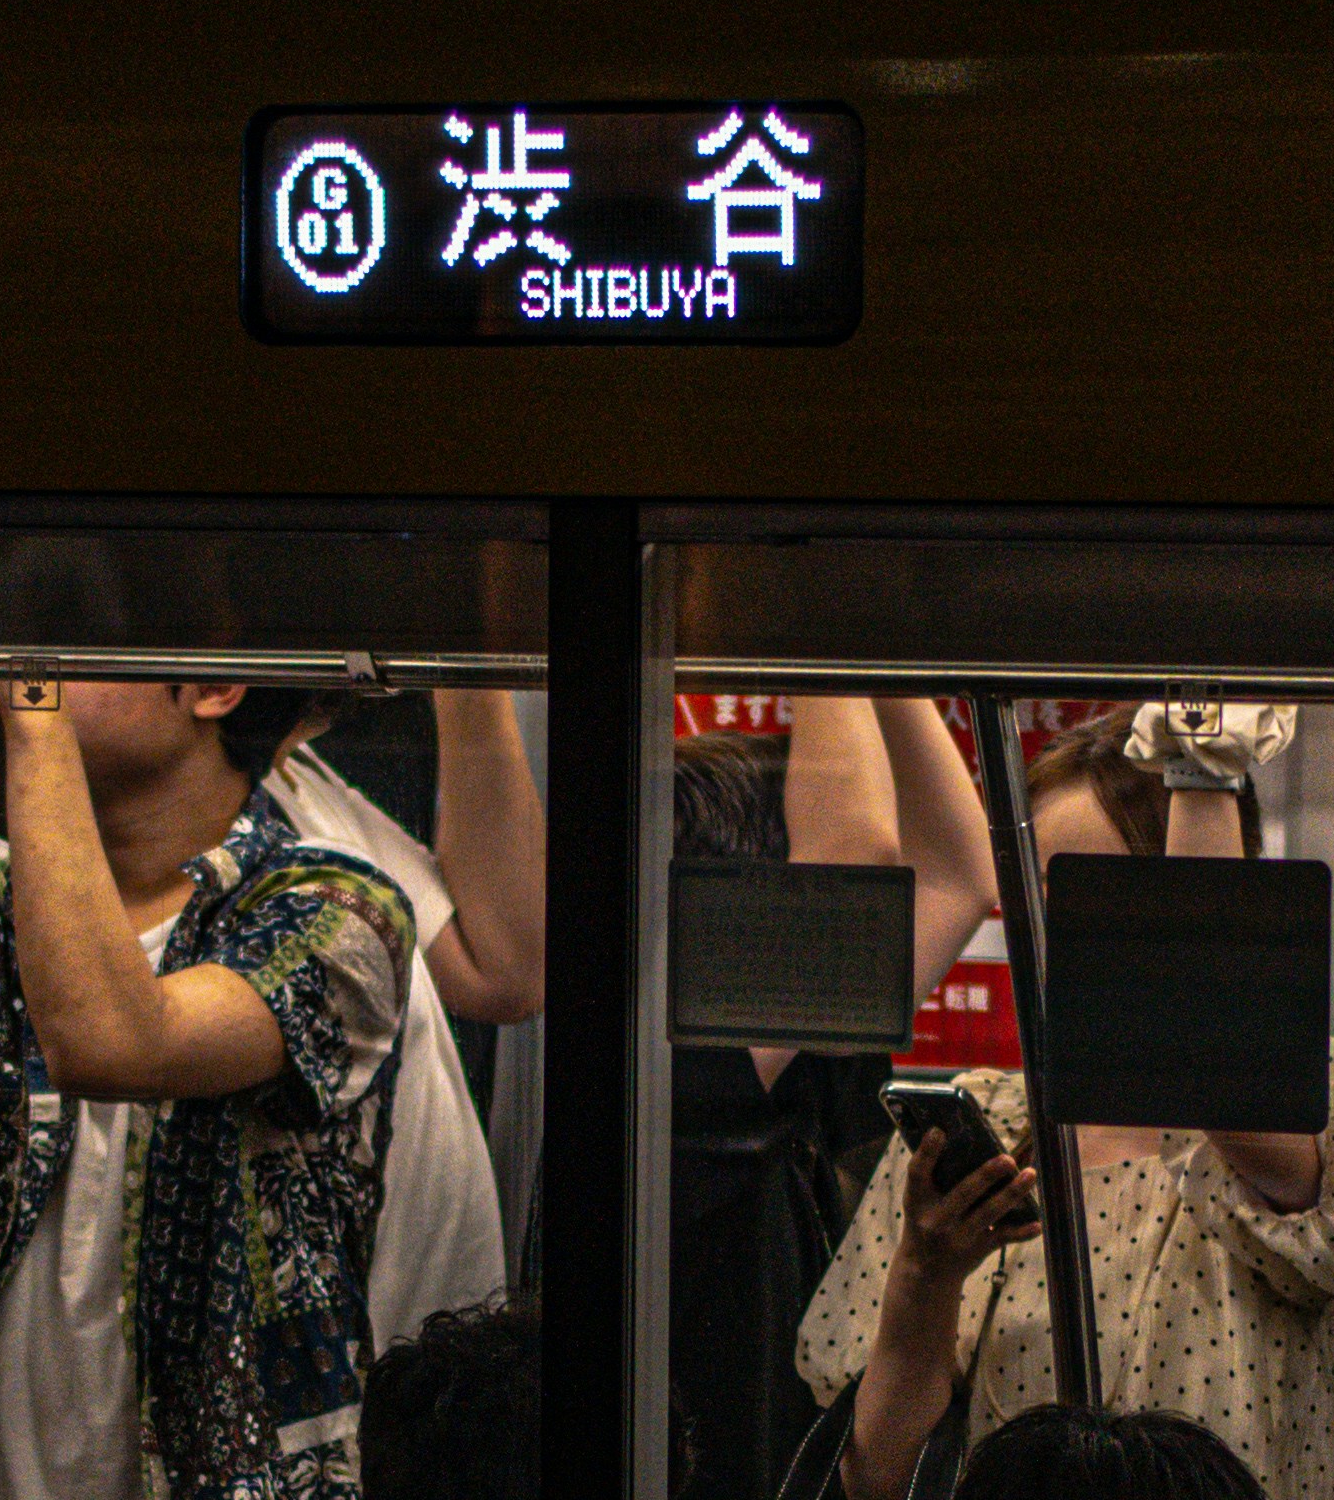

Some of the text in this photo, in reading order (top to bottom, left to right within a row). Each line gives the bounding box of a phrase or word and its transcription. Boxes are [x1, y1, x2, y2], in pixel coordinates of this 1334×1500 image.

[311, 167, 349, 211] G
[439, 109, 822, 267] 渋谷
[296, 211, 360, 255] 01
[519, 267, 738, 320] SHIBUYA
